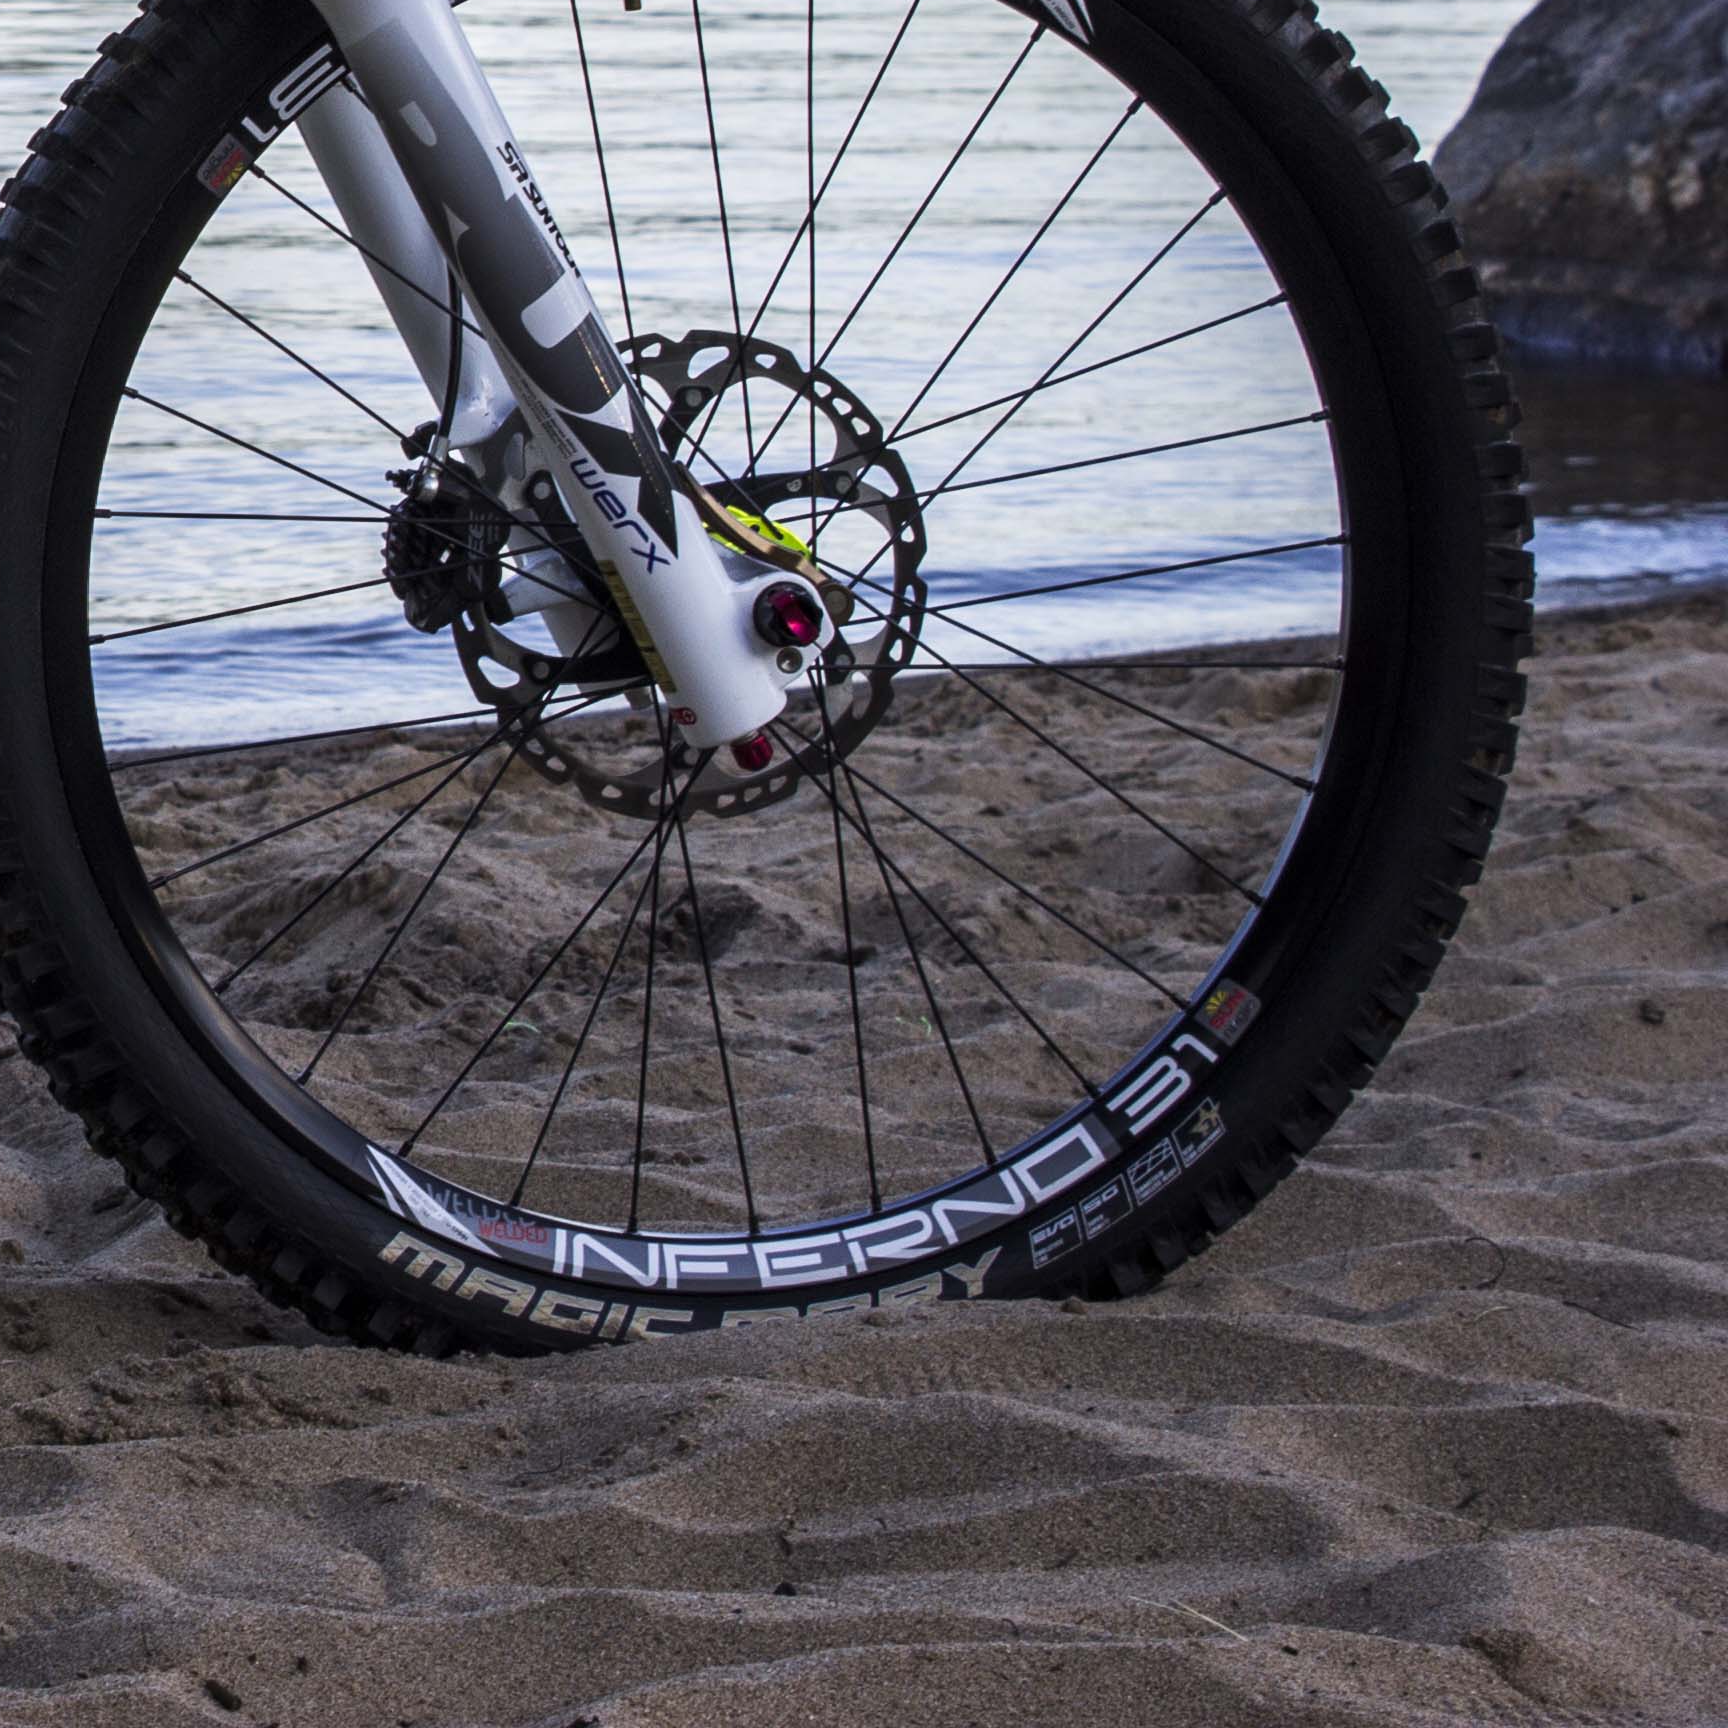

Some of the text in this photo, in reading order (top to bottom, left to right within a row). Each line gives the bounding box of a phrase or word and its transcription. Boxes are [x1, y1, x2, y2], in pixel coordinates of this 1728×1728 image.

[570, 458, 671, 574] werx
[553, 1124, 1104, 1290] INFERNO
[1105, 1035, 1220, 1137] 31
[377, 1231, 694, 1341] MAGIC
